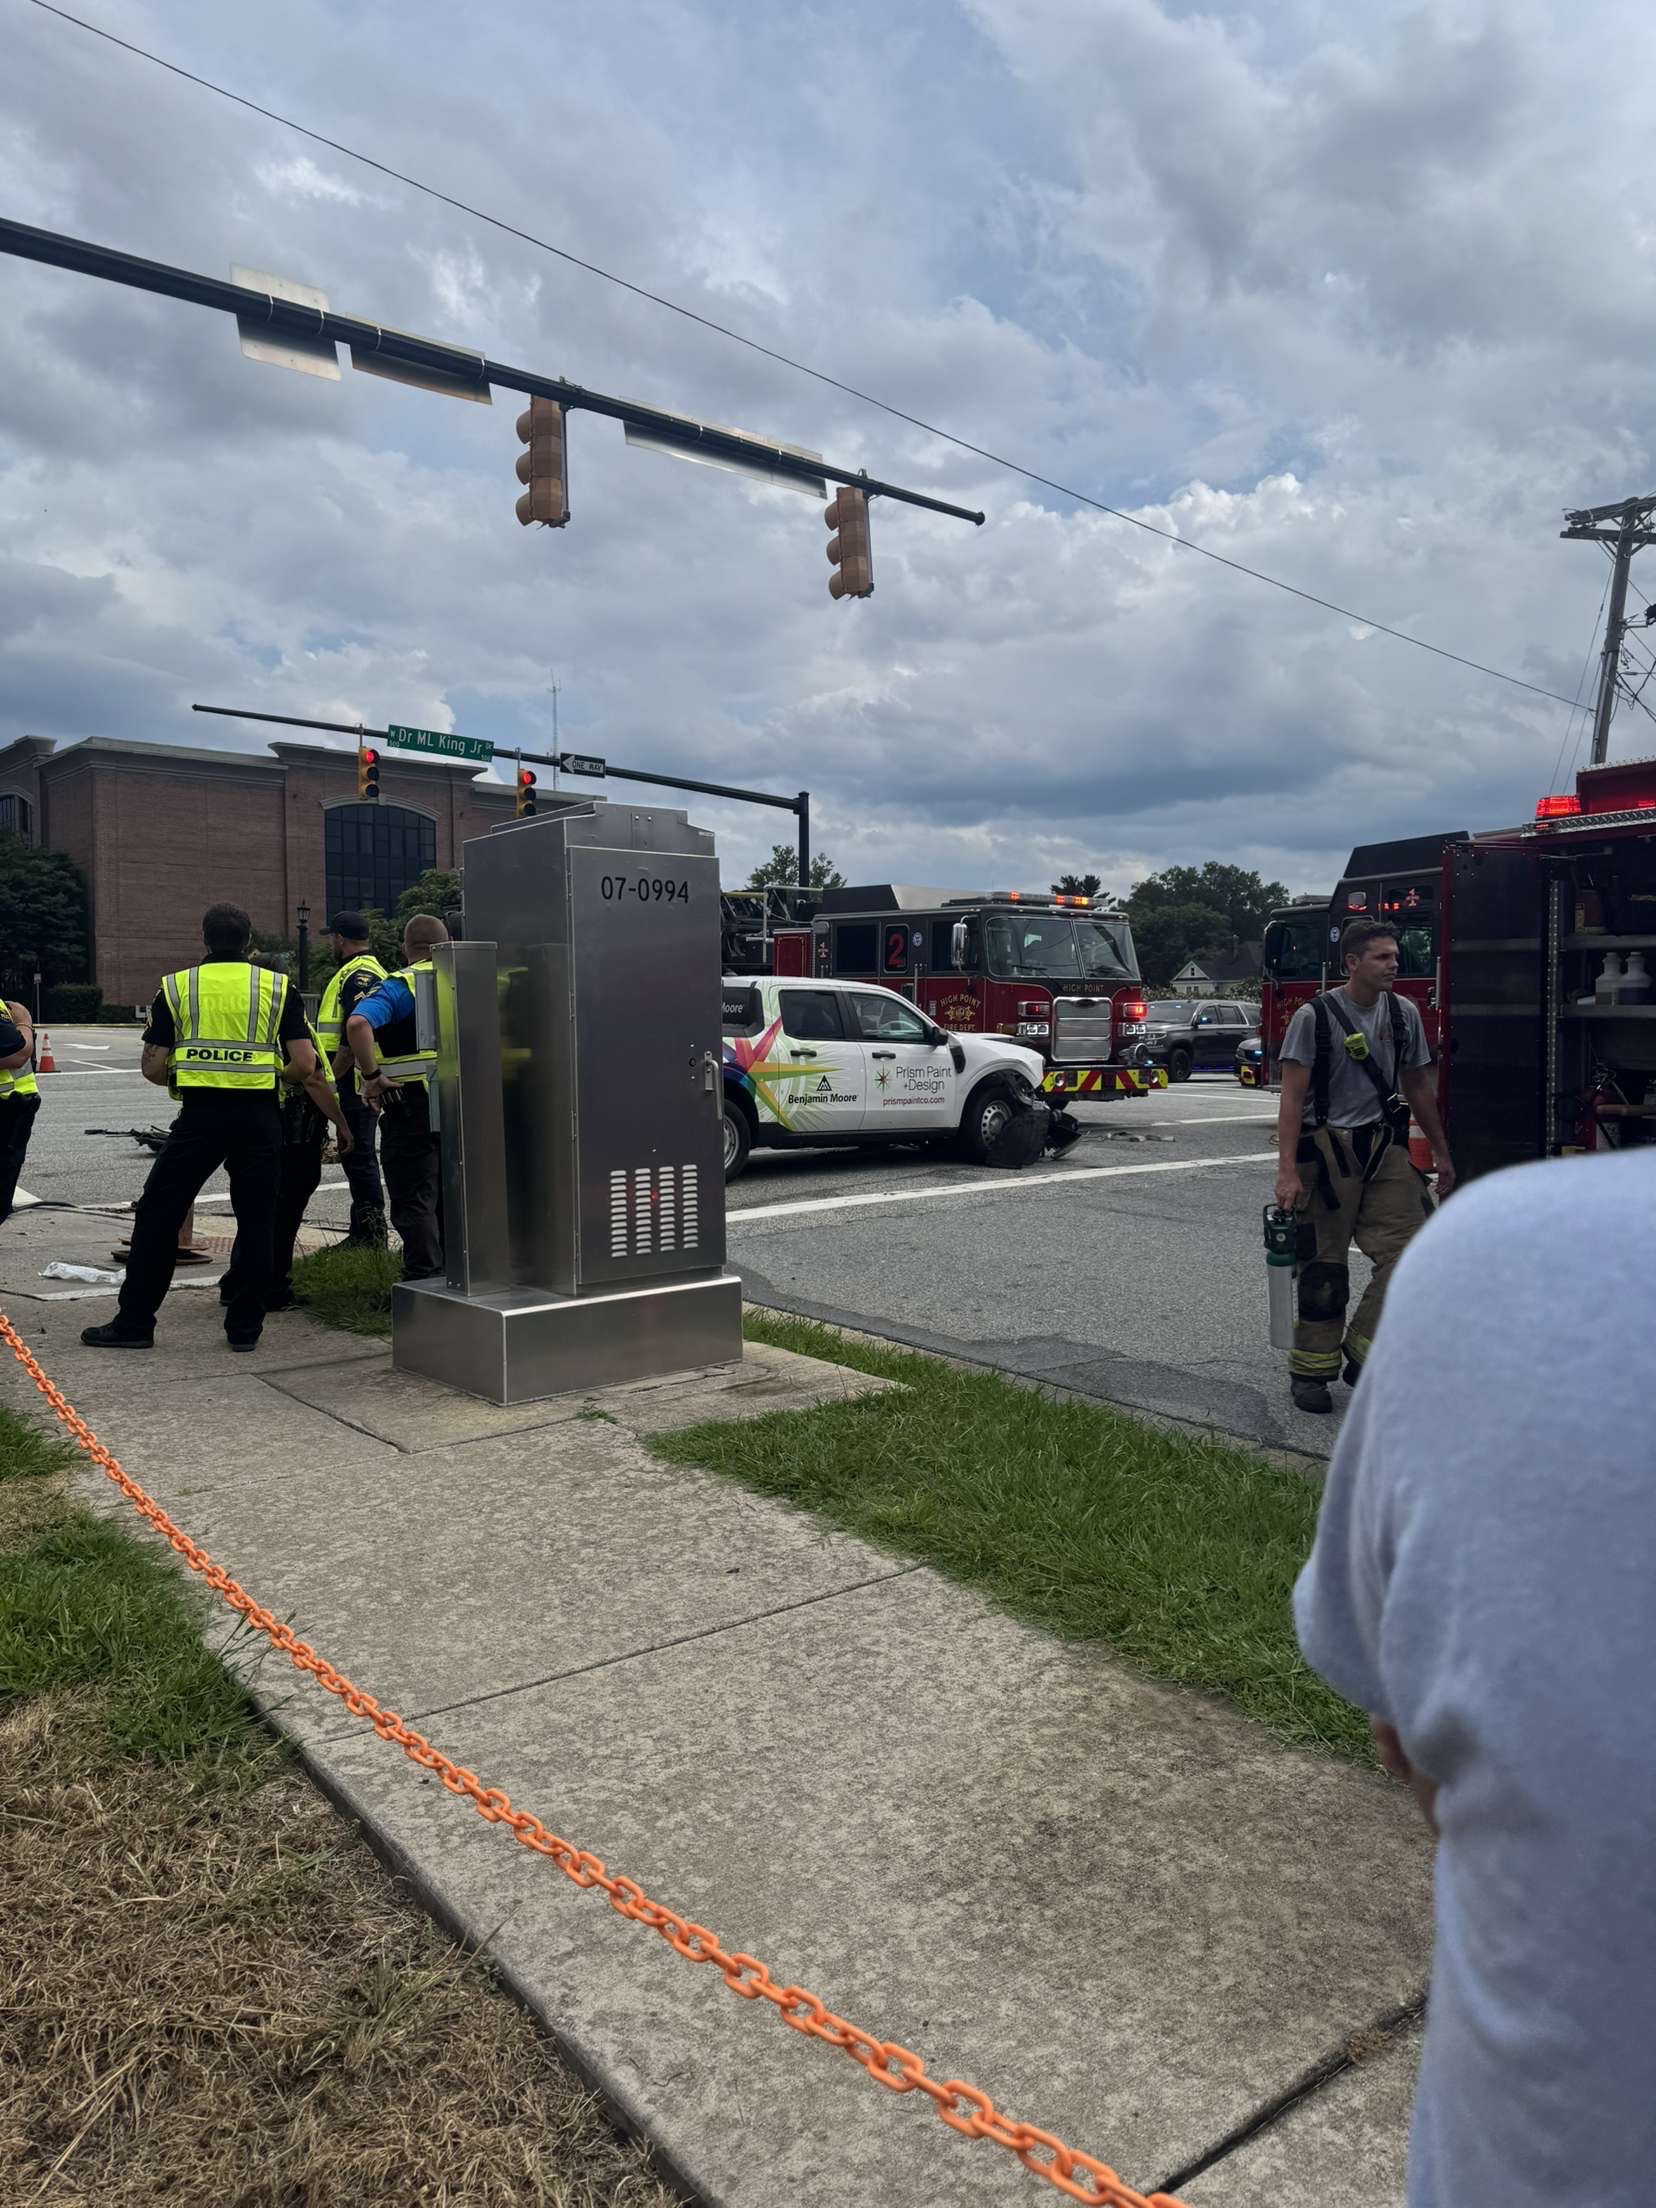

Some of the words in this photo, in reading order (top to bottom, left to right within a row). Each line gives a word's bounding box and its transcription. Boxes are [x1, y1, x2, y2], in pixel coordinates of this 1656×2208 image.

[399, 728, 413, 743] Dr
[417, 732, 434, 747] ML
[439, 735, 466, 755] King
[470, 740, 482, 754] Jr
[572, 760, 585, 770] ONE
[601, 876, 688, 904] 07-0994
[888, 932, 905, 966] 2
[1084, 984, 1104, 992] POINT
[940, 994, 958, 1007] HIGH
[960, 993, 981, 1008] POINT
[944, 1023, 958, 1032] FIRE
[186, 1049, 253, 1062] POLICE
[896, 1066, 925, 1078] Prism
[927, 1065, 952, 1078] Paint
[788, 1093, 828, 1106] Benjamin
[830, 1093, 857, 1103] Moore
[882, 1096, 945, 1107] prismpaintco.com
